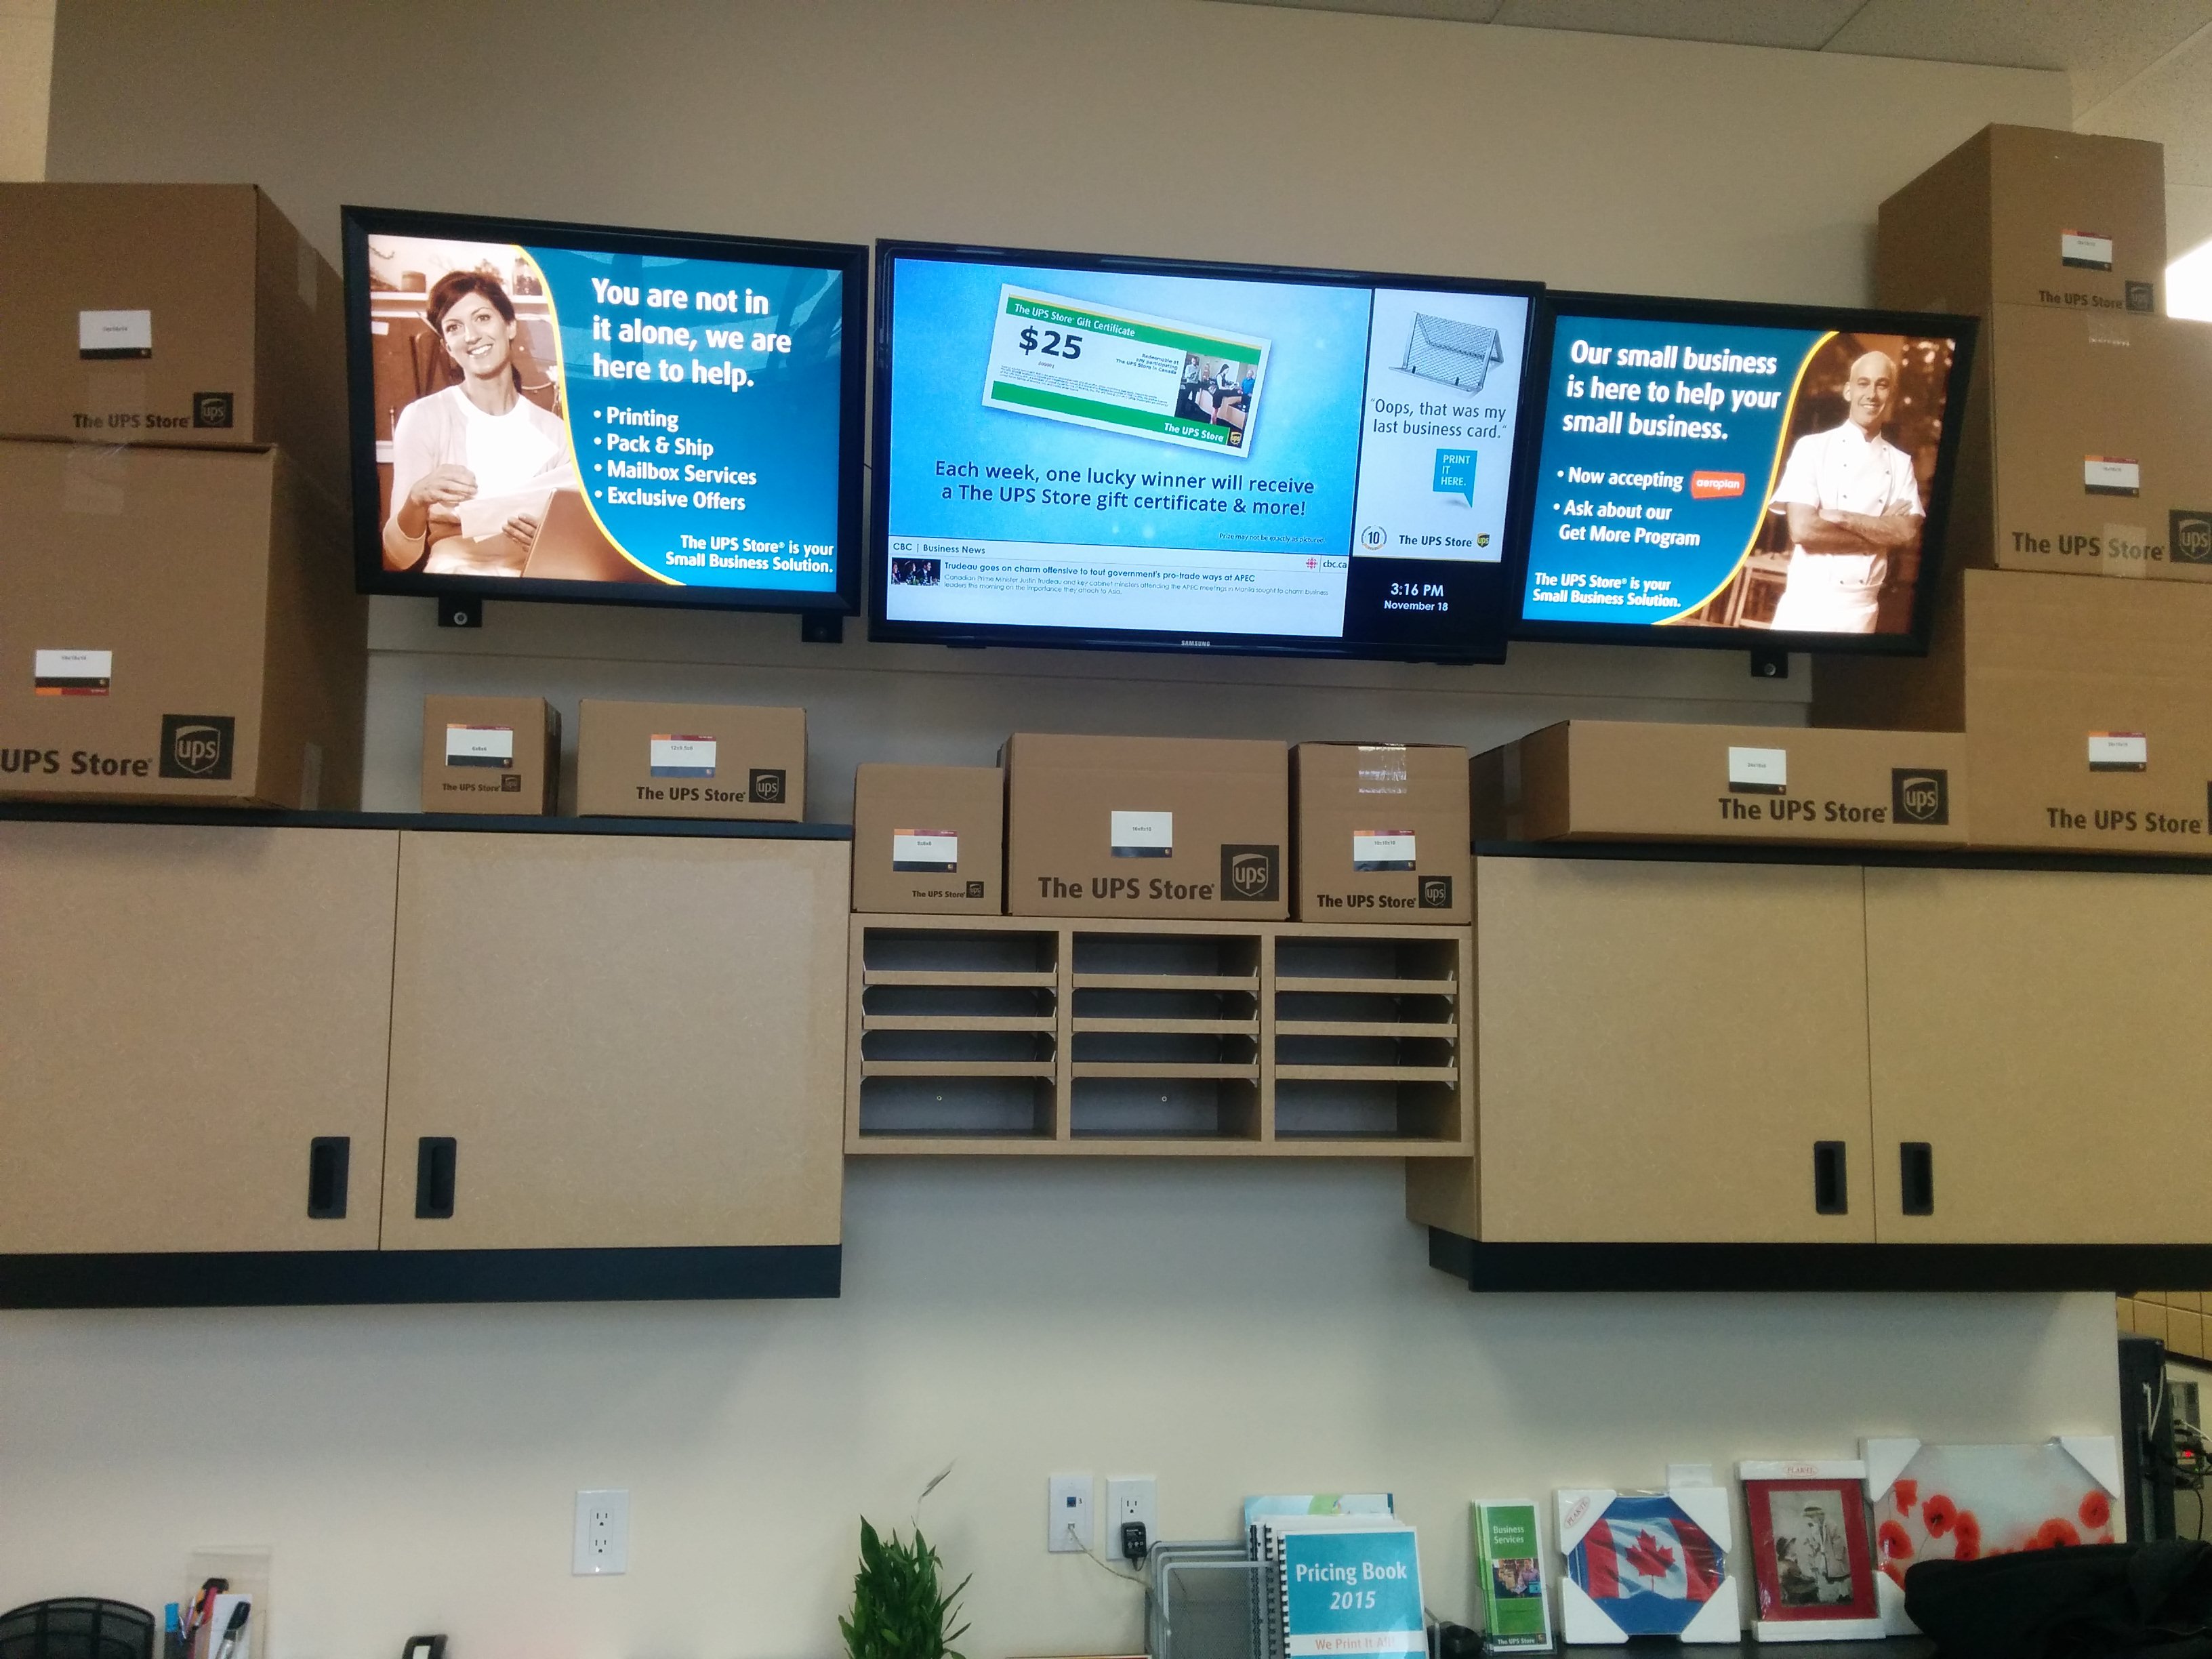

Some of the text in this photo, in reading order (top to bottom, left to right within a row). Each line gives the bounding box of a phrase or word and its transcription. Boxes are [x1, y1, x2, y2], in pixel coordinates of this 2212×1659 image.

[592, 277, 769, 314] You are not in
[1015, 304, 1030, 314] The
[1032, 307, 1049, 319] UPS
[1077, 317, 1091, 327] Gift
[1094, 321, 1135, 337] Certificate
[593, 316, 792, 353] it alone, we are
[1019, 325, 1082, 359] $25
[1571, 340, 1777, 375] Our small business
[593, 352, 754, 392] here to help.
[1567, 374, 1782, 412] is here to help your
[73, 413, 103, 429] The
[108, 413, 141, 428] UPS
[607, 407, 678, 432] Printing
[1420, 401, 1447, 416] that
[1453, 407, 1479, 417] was
[1484, 408, 1506, 422] my
[1374, 419, 1398, 433] last
[1404, 420, 1462, 436] business
[1563, 411, 1728, 440] small business.
[607, 433, 714, 460] Pack & Ship
[1442, 466, 1450, 474] IT
[1443, 455, 1470, 464] PRINT
[607, 459, 757, 485] Mailbox Services
[936, 460, 1314, 493] Each week, one lucky winner will receive
[1441, 476, 1466, 486] HERE.
[1568, 467, 1684, 493] Now accepting
[1696, 478, 1740, 490] aeroplan
[608, 487, 745, 510] Exclusive Offers
[942, 485, 1305, 516] a The UPS Store gift certificate & more!
[1563, 499, 1673, 520] Ask about our
[680, 535, 834, 558] The UPS is your
[1368, 531, 1380, 544] 10
[1559, 524, 1700, 549] Get More Program
[2012, 531, 2100, 556] The UPS
[893, 543, 985, 554] CBC Business News
[666, 551, 833, 573] Small Business Solution.
[945, 562, 977, 570] Trudeau
[1042, 567, 1078, 575] offensive
[1163, 572, 1200, 580] pro-trade
[1323, 560, 1347, 568] cbc.ca
[1391, 583, 1443, 596] 3:16 PM
[1535, 572, 1671, 593] The UPS is your
[1384, 600, 1448, 611] November 18
[1532, 588, 1681, 607] Small Business Solution.
[1, 748, 60, 774] UPS
[178, 740, 216, 766] ups
[636, 786, 664, 800] The
[670, 787, 699, 801] UPS
[756, 782, 779, 798] ups
[1903, 789, 1936, 811] ups
[1719, 798, 1761, 820] The
[1770, 800, 1816, 821] UPS
[2047, 807, 2200, 834] The UPS Store
[1235, 864, 1265, 888] ups
[1038, 877, 1212, 900] The UPS Store
[1425, 887, 1446, 903] ups
[1317, 895, 1343, 907] The
[1347, 895, 1374, 907] UPS
[1493, 1525, 1524, 1544] Business Services
[1296, 1561, 1407, 1586] Pricing Book
[1330, 1591, 1376, 1610] 2015
[1315, 1637, 1372, 1650] We Print It
